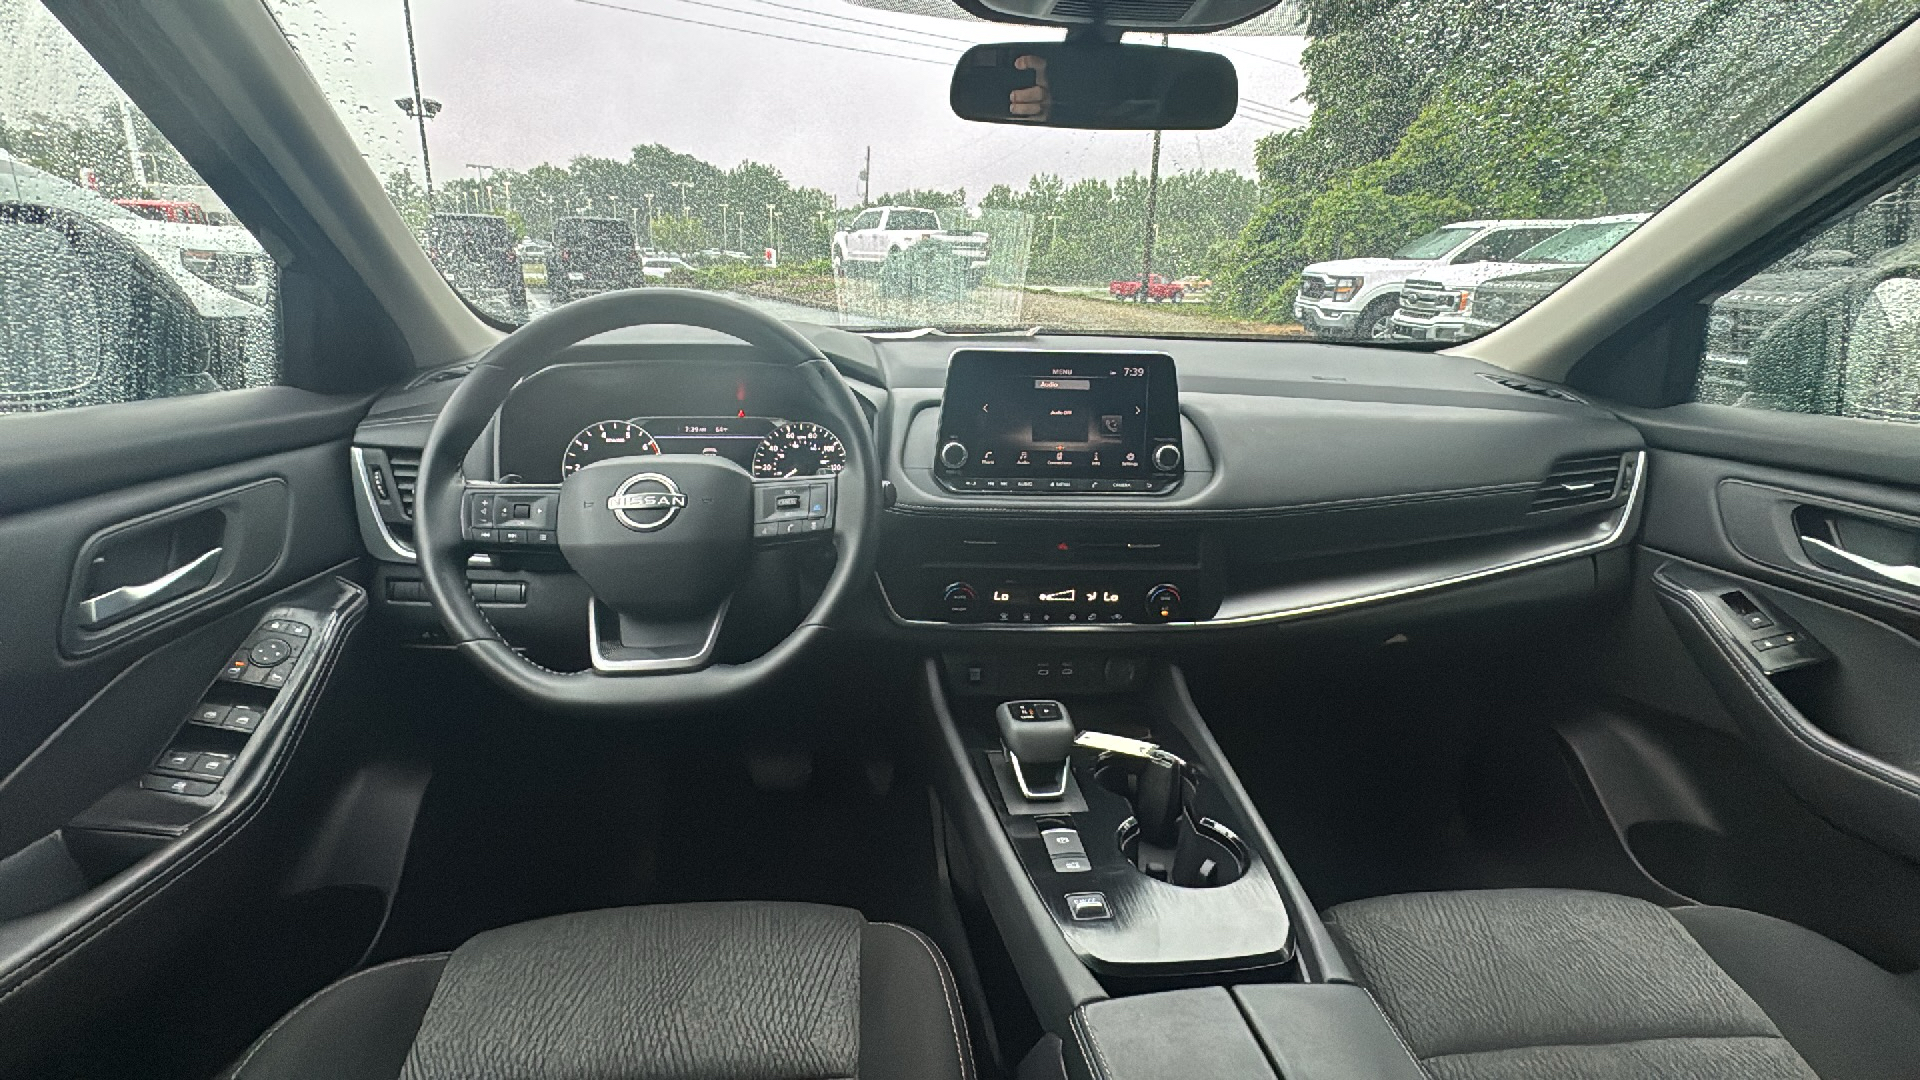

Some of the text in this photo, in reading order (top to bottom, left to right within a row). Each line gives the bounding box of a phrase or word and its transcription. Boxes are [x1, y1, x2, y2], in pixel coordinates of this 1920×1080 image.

[1123, 367, 1144, 377] 7:39
[642, 443, 649, 451] 6
[762, 463, 773, 471] 20
[830, 463, 842, 471] 120
[611, 495, 685, 507] NISSAN
